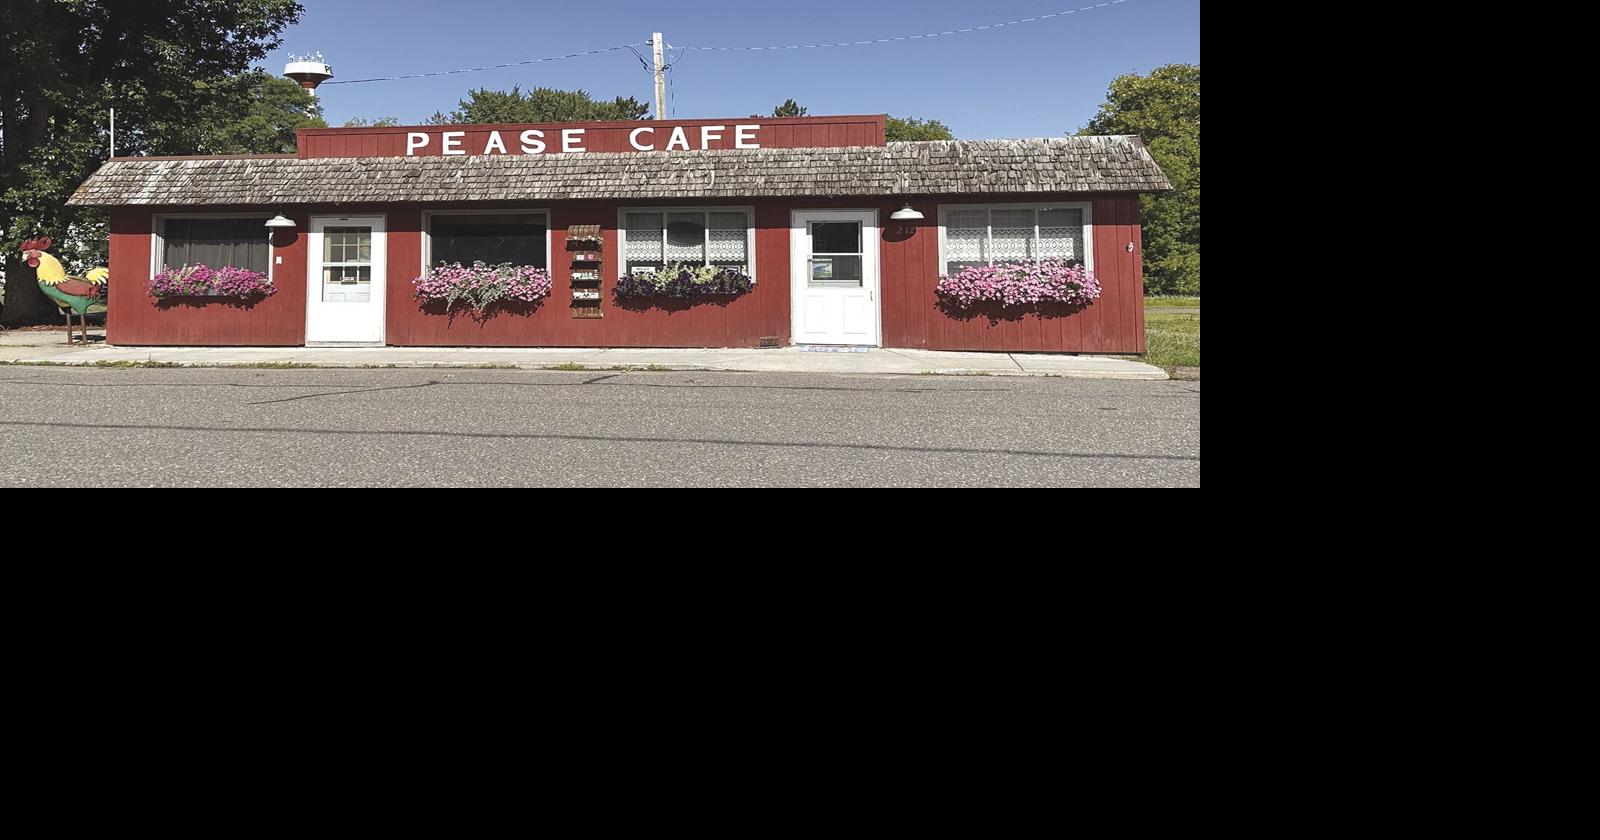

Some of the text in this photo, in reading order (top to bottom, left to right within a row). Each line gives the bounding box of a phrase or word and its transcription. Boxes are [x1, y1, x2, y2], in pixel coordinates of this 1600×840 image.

[406, 124, 760, 156] PEASE CAFE
[896, 226, 915, 235] 212
